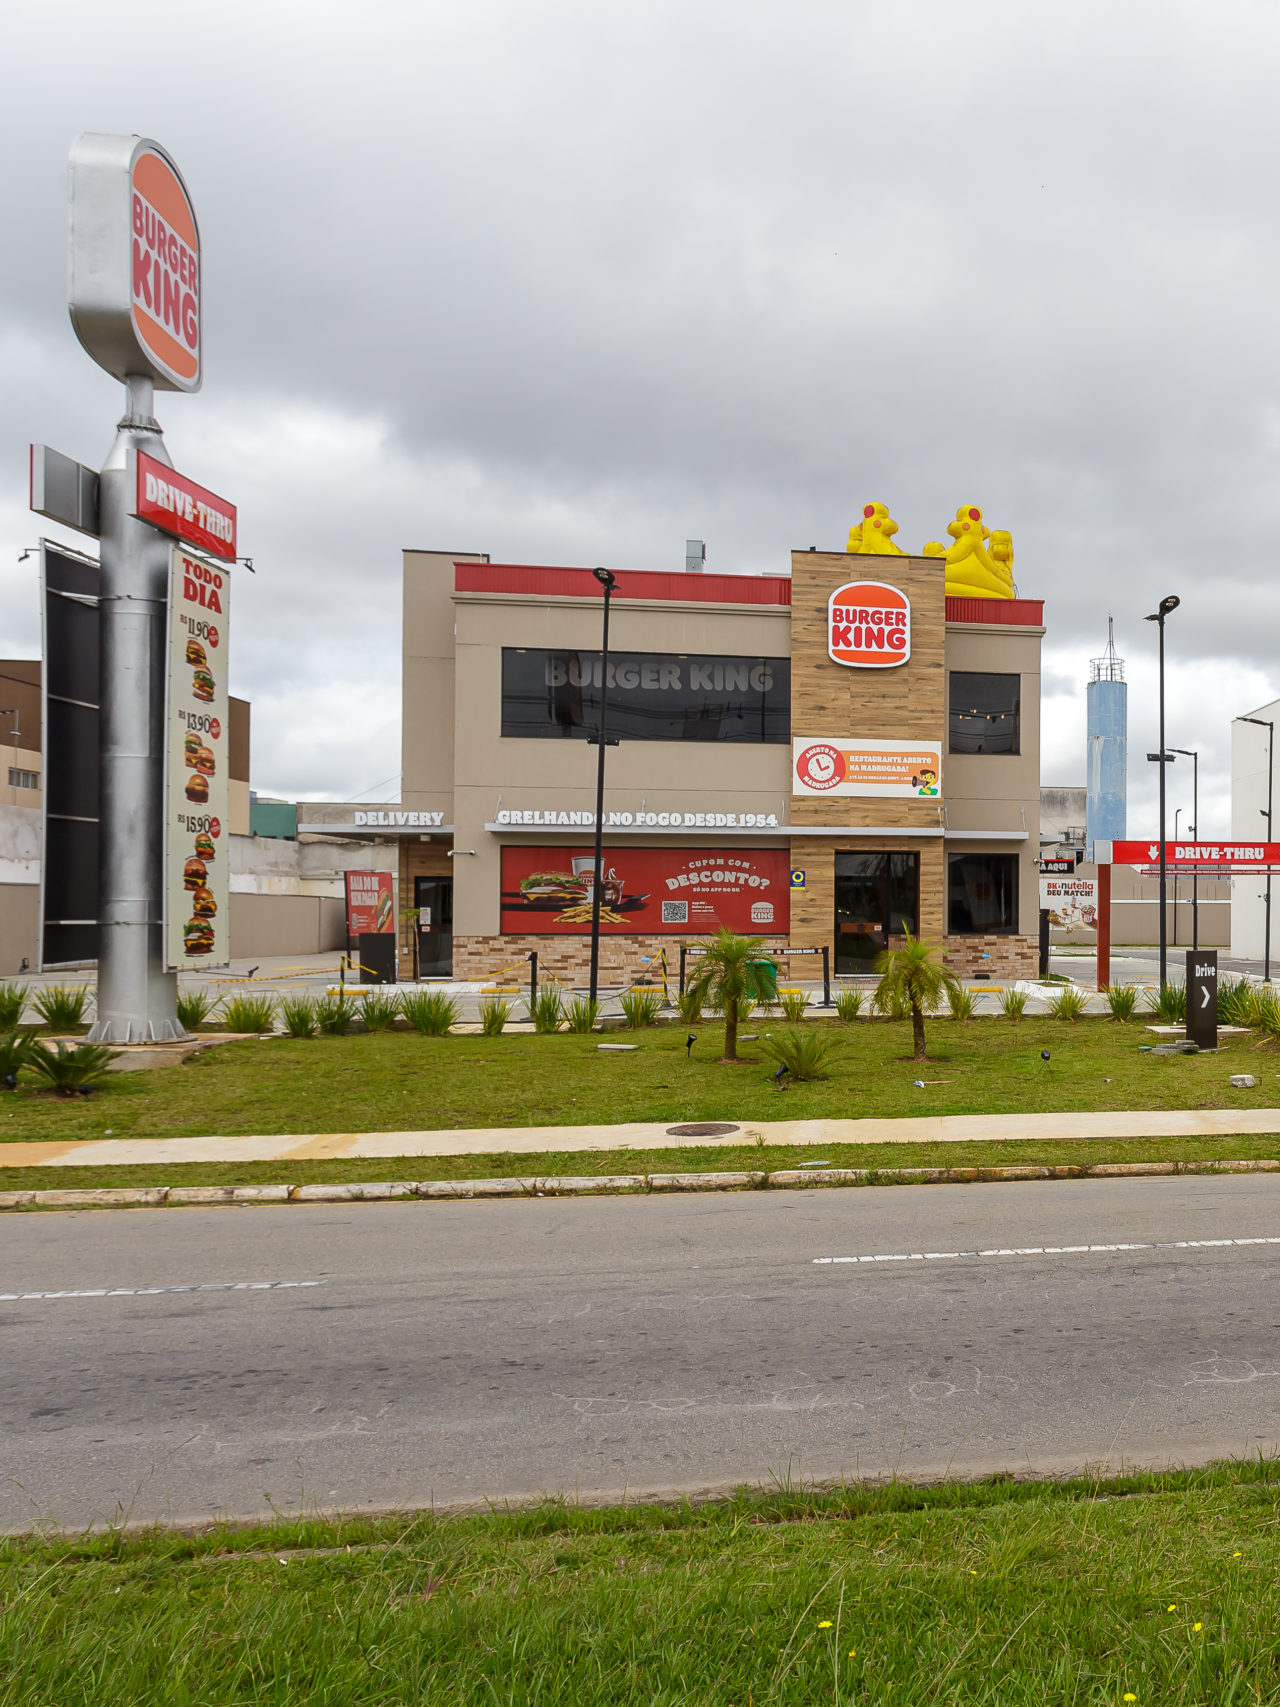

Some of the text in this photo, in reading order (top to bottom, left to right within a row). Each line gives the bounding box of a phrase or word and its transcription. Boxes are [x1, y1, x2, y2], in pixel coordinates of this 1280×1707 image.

[132, 193, 198, 297] BURGER
[132, 238, 198, 350] KING
[145, 472, 233, 544] DRIVE-THRU
[182, 557, 223, 590] TODO
[183, 575, 223, 614] DIA
[832, 607, 907, 627] BURGER
[832, 625, 906, 650] KING
[545, 660, 774, 692] BURGER KING
[849, 755, 902, 763] RESTAURANTE
[803, 775, 840, 789] MADRUGADA
[354, 811, 444, 826] DELIVERY
[497, 810, 778, 827] GRELHANDO NO FOGO DESDE 1954
[1175, 847, 1264, 860] DRIVE-THRU
[688, 858, 751, 869] CUPOM COM
[1047, 862, 1068, 872] AQUI
[665, 870, 771, 891] DESCONTO?
[1061, 881, 1094, 890] nutella
[1063, 889, 1094, 897] MATCH!
[751, 912, 774, 920] KING
[1195, 964, 1216, 977] Drive
